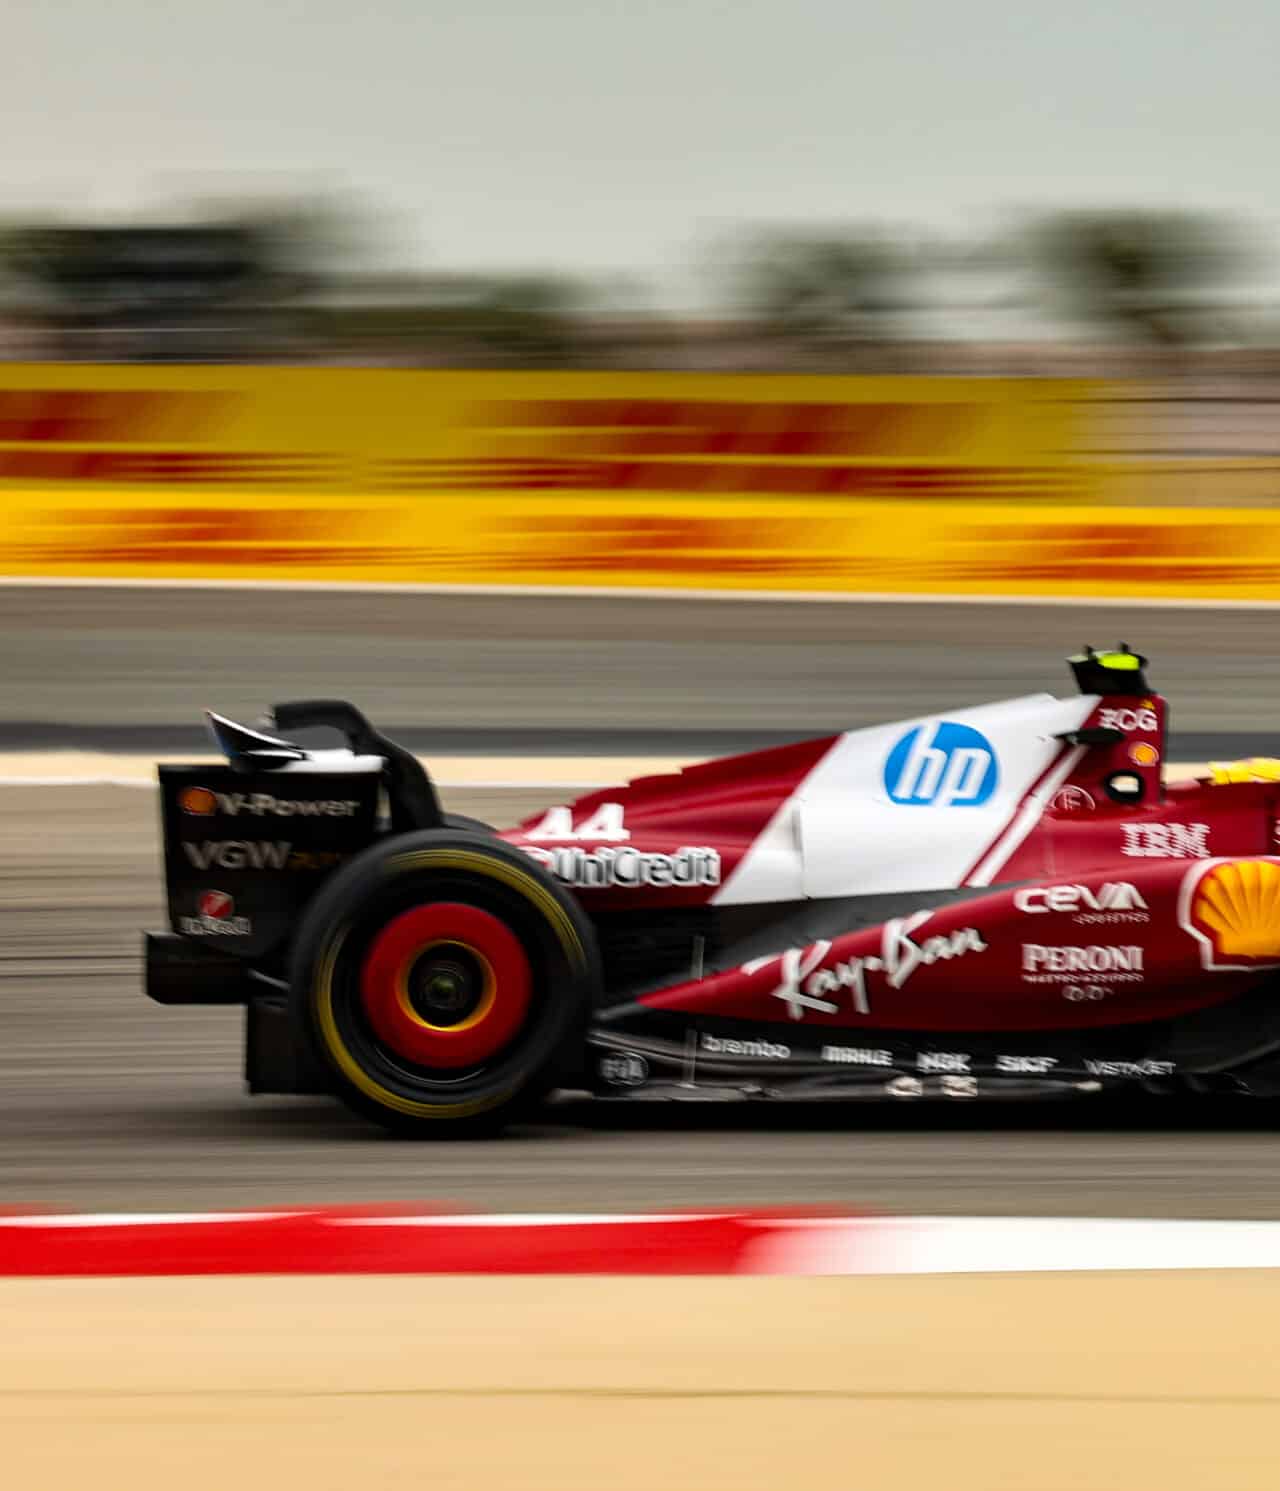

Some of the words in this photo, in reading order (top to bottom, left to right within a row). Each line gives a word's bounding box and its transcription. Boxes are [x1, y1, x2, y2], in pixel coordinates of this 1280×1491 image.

[893, 721, 991, 807] hp
[218, 792, 360, 816] V-Power
[521, 803, 631, 841] 44
[182, 841, 292, 870] VGW
[1120, 823, 1210, 857] IBM
[552, 847, 721, 887] UniCredit
[772, 909, 988, 1020] Ray-Ban
[1021, 943, 1144, 971] PERONI
[702, 1035, 791, 1058] brembo
